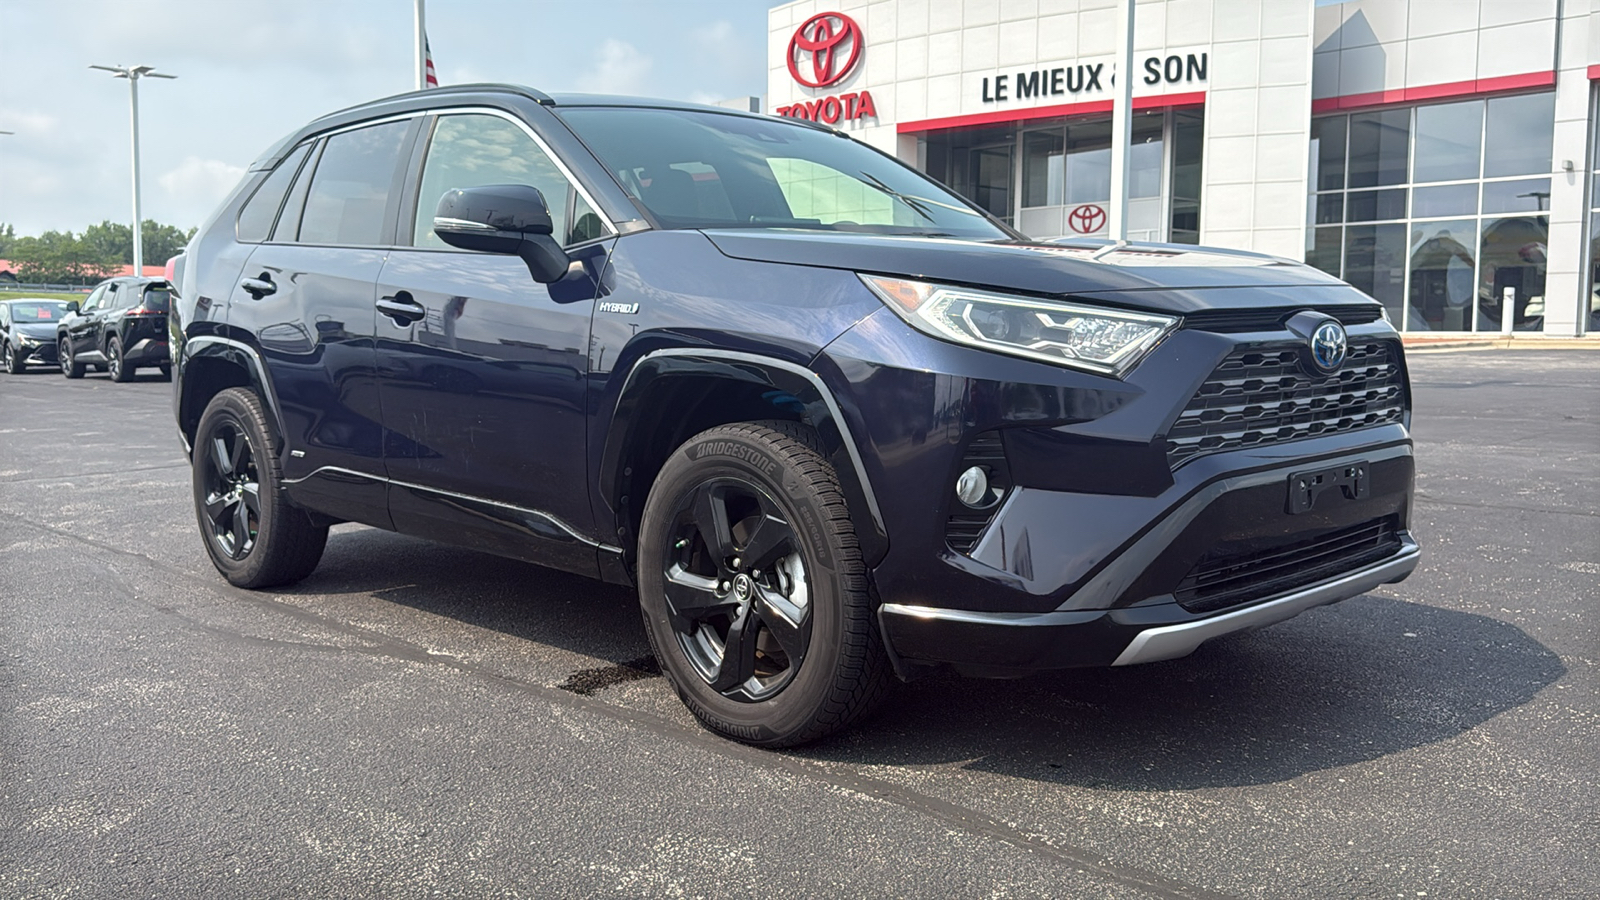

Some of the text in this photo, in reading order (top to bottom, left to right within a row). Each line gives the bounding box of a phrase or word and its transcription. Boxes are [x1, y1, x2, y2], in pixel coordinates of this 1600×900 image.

[982, 75, 1008, 103] LE
[1016, 63, 1103, 99] MIEUX
[1143, 53, 1207, 85] SON
[599, 302, 632, 314] HYBRID
[696, 441, 777, 475] BRIDGESTONE
[685, 696, 761, 740] BRIDGESTONE
